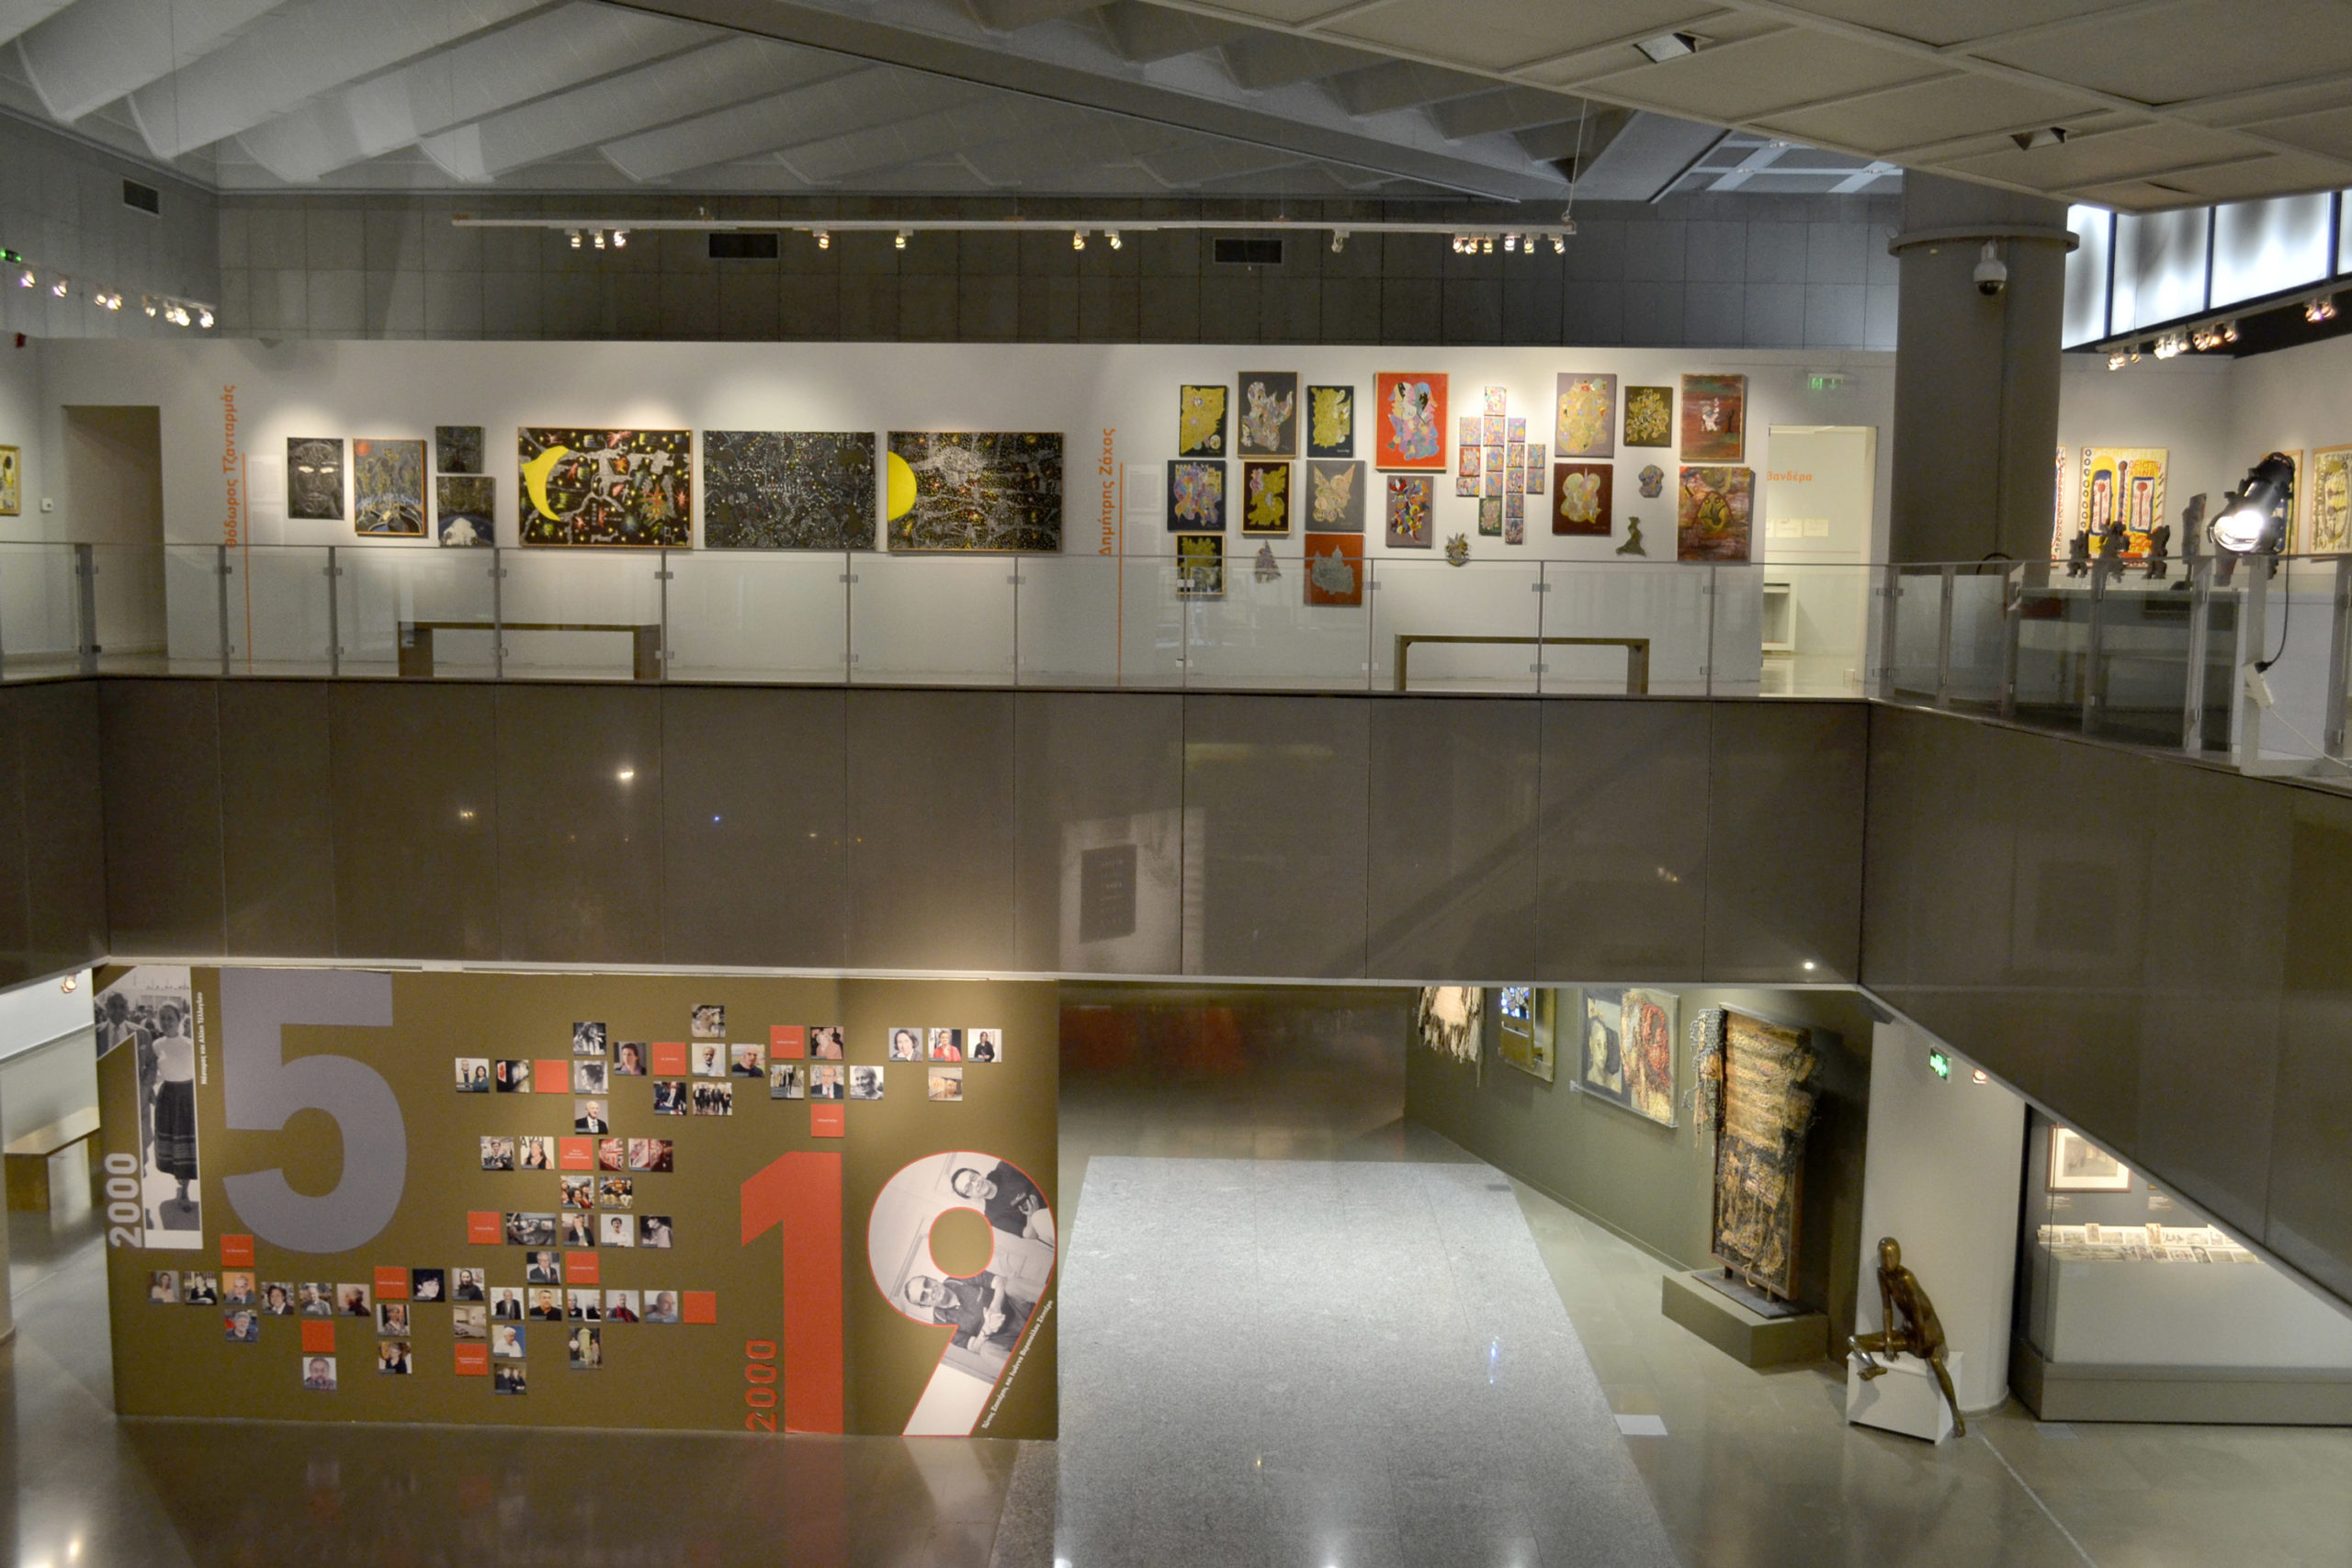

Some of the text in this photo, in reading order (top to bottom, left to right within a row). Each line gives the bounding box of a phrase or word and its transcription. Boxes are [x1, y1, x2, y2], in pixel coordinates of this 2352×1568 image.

[220, 384, 240, 548] Θόδωρος Τζανταρμάς
[1097, 427, 1116, 558] Δημήτρης Ζάχος
[104, 1153, 143, 1248] 2000
[741, 1150, 1057, 1438] 19
[745, 1339, 778, 1432] 2000
